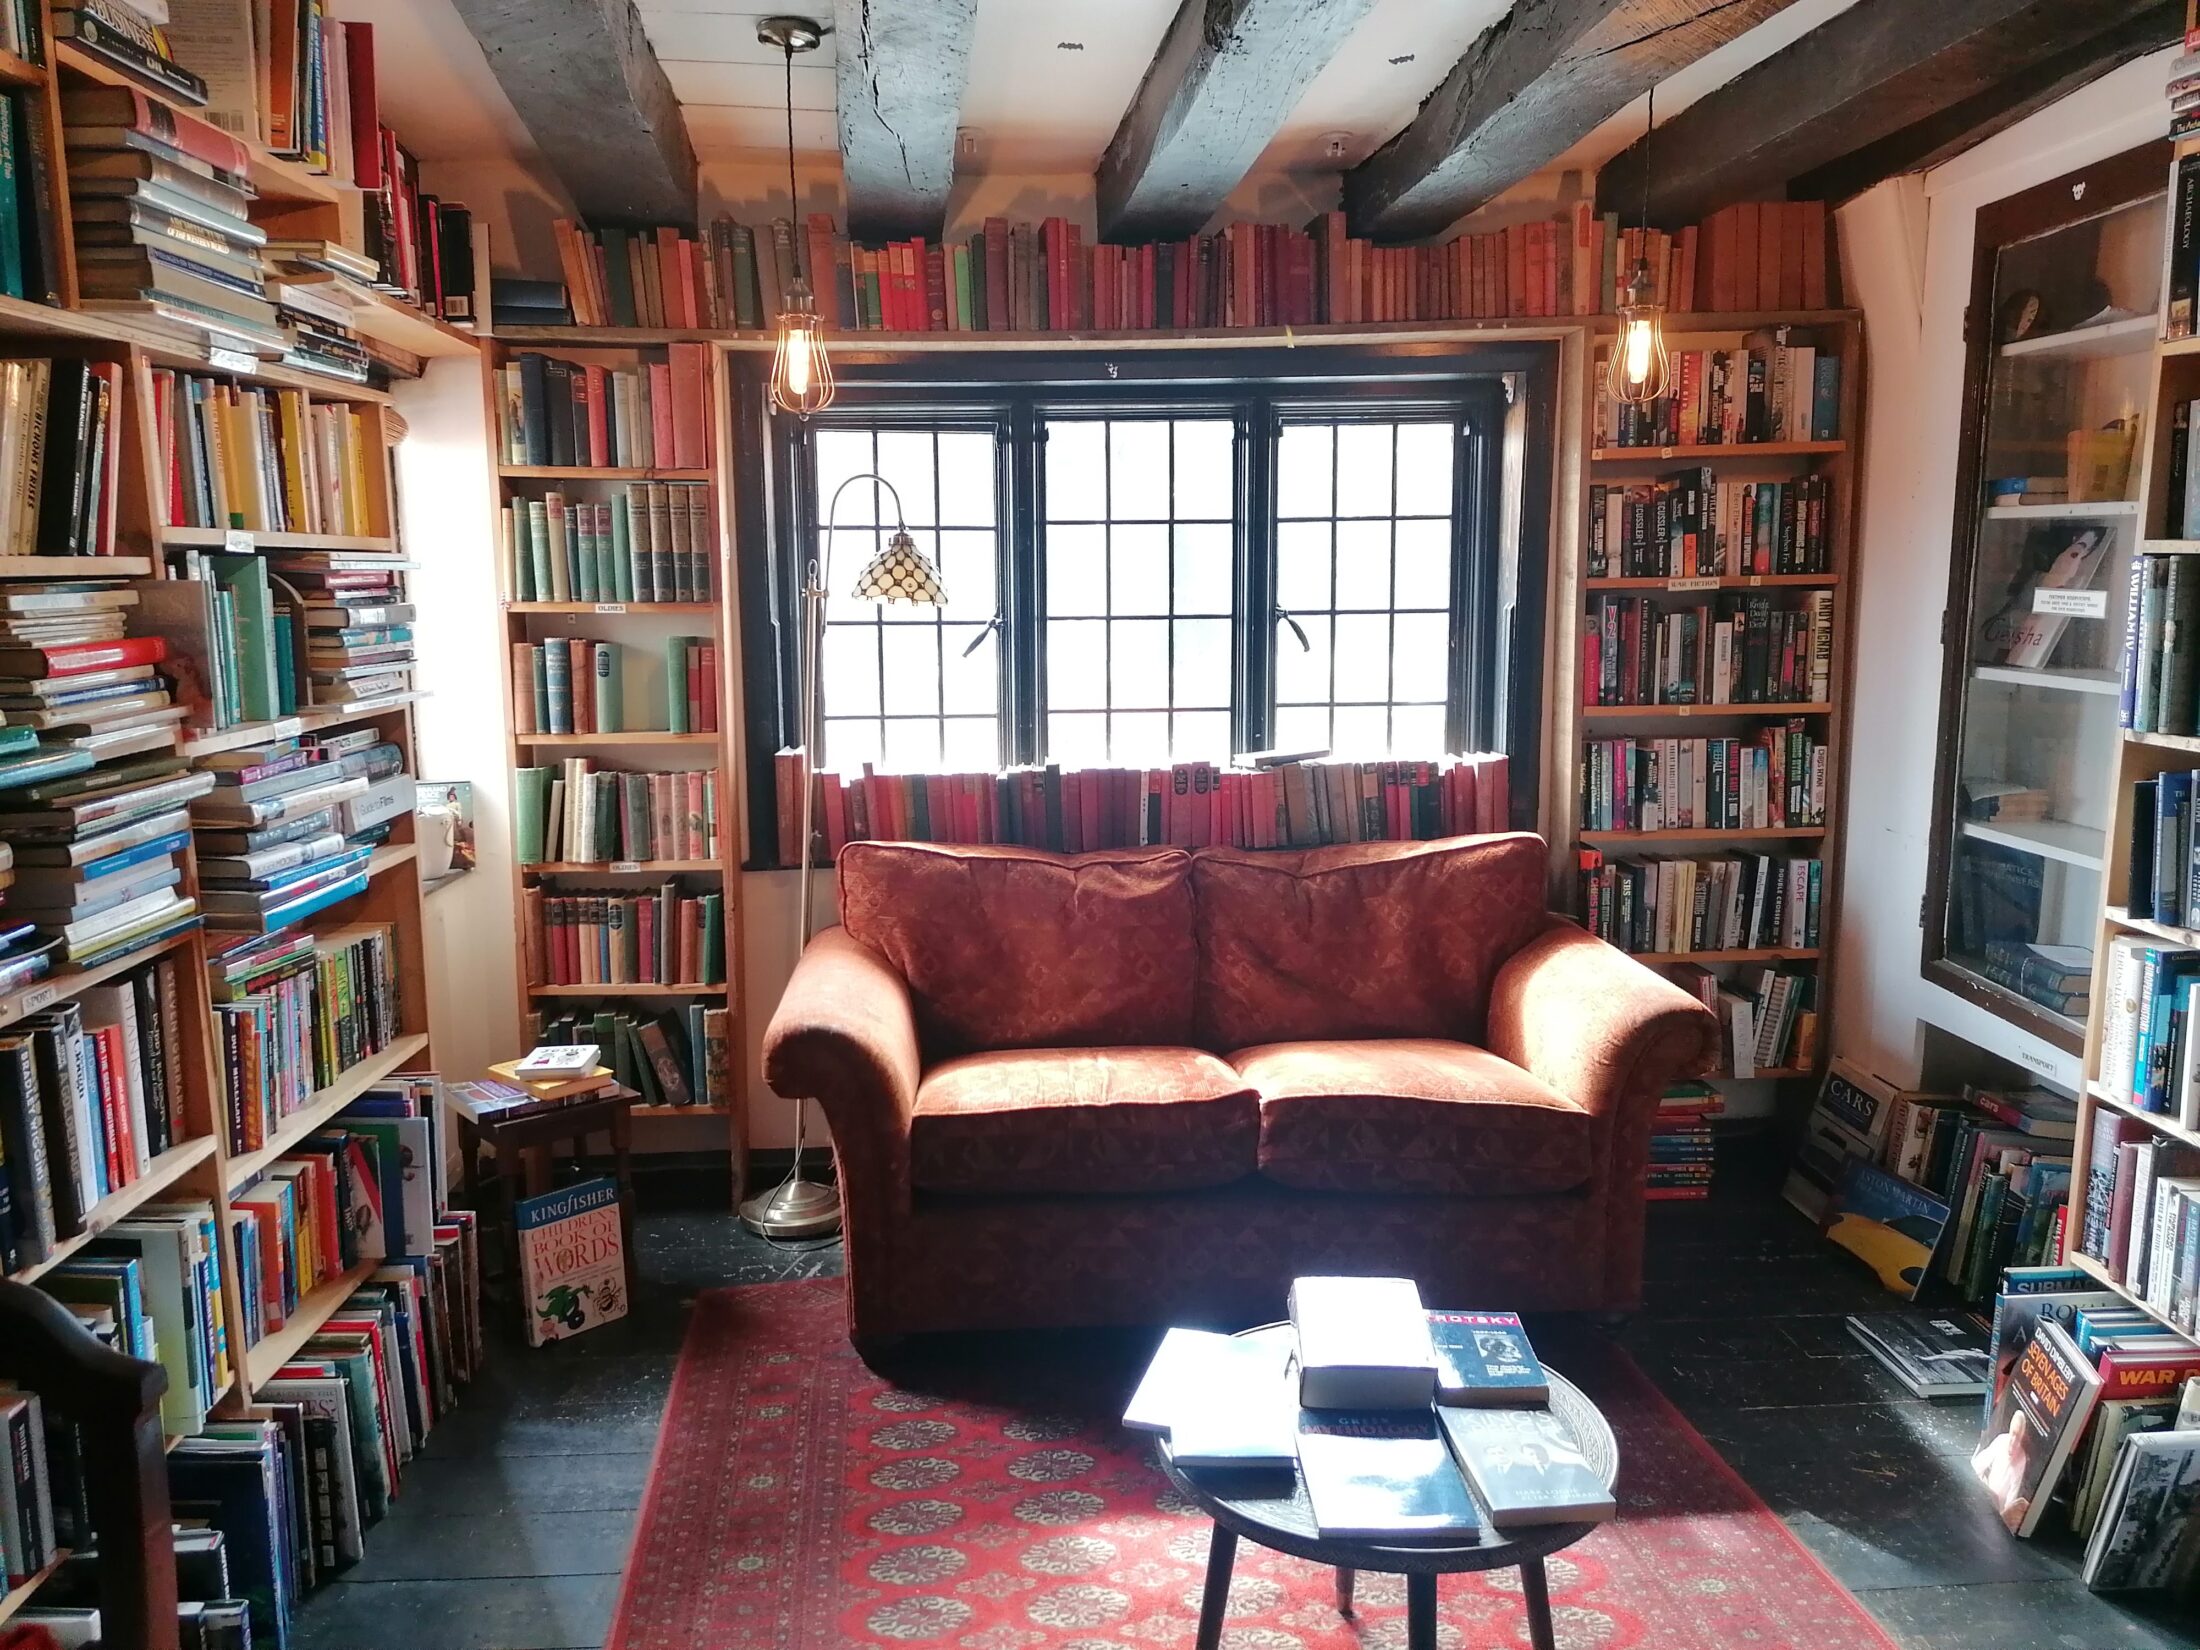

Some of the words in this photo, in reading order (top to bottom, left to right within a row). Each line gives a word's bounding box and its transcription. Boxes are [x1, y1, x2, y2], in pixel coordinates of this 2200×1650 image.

[2183, 178, 2194, 248] ARCHAEOLOGY
[27, 468, 38, 510] FRISES
[1636, 507, 1644, 539] CUSSLER
[1657, 505, 1665, 537] CUSSLER
[1783, 526, 1792, 551] Stephen
[1690, 580, 1718, 588] FICTION
[598, 604, 624, 612] OLDIES
[1819, 597, 1833, 621] ANDY
[2129, 572, 2141, 630] WILLIAM
[1607, 606, 1617, 639] V2
[2126, 632, 2134, 650] IV
[1792, 733, 1802, 758] CHRIS
[1792, 759, 1801, 781] RYAN
[1816, 769, 1824, 787] RYAN
[380, 795, 394, 808] Films
[612, 863, 639, 871] OLDIES
[1590, 878, 1599, 907] CHRIS
[1623, 879, 1631, 896] SBS
[1796, 865, 1806, 903] ESCAPE
[1589, 908, 1598, 934] RYAN
[1774, 896, 1782, 925] CROSSED
[2144, 962, 2156, 1001] EUROPEAN
[168, 970, 178, 1037] STEVEN
[2140, 1002, 2151, 1032] HISTORY
[170, 1042, 183, 1114] GERRARD
[2021, 1053, 2054, 1072] TRANSPORT
[61, 1083, 76, 1141] GOLDEN
[1831, 1080, 1873, 1117] CARS
[1980, 1097, 1999, 1113] cars
[20, 1051, 35, 1119] BRADLEY
[29, 1121, 44, 1181] WIGGINS
[105, 1101, 116, 1153] FOOTBALLER
[531, 1207, 617, 1243] CHILDREN'S
[533, 1234, 586, 1257] BOOK
[592, 1221, 615, 1239] OF
[534, 1234, 620, 1280] WORDS
[1995, 1305, 2003, 1336] ROYAL
[2035, 1327, 2052, 1352] DAVID
[2050, 1348, 2076, 1383] DIMBLEBY
[1989, 1357, 1998, 1388] FORCE
[2027, 1341, 2051, 1372] SEVEN
[2047, 1368, 2070, 1401] AGES
[2119, 1368, 2175, 1386] WAR
[2021, 1358, 2033, 1376] OF
[2029, 1370, 2061, 1418] BRITAIN
[1460, 1411, 1553, 1426] KING'S
